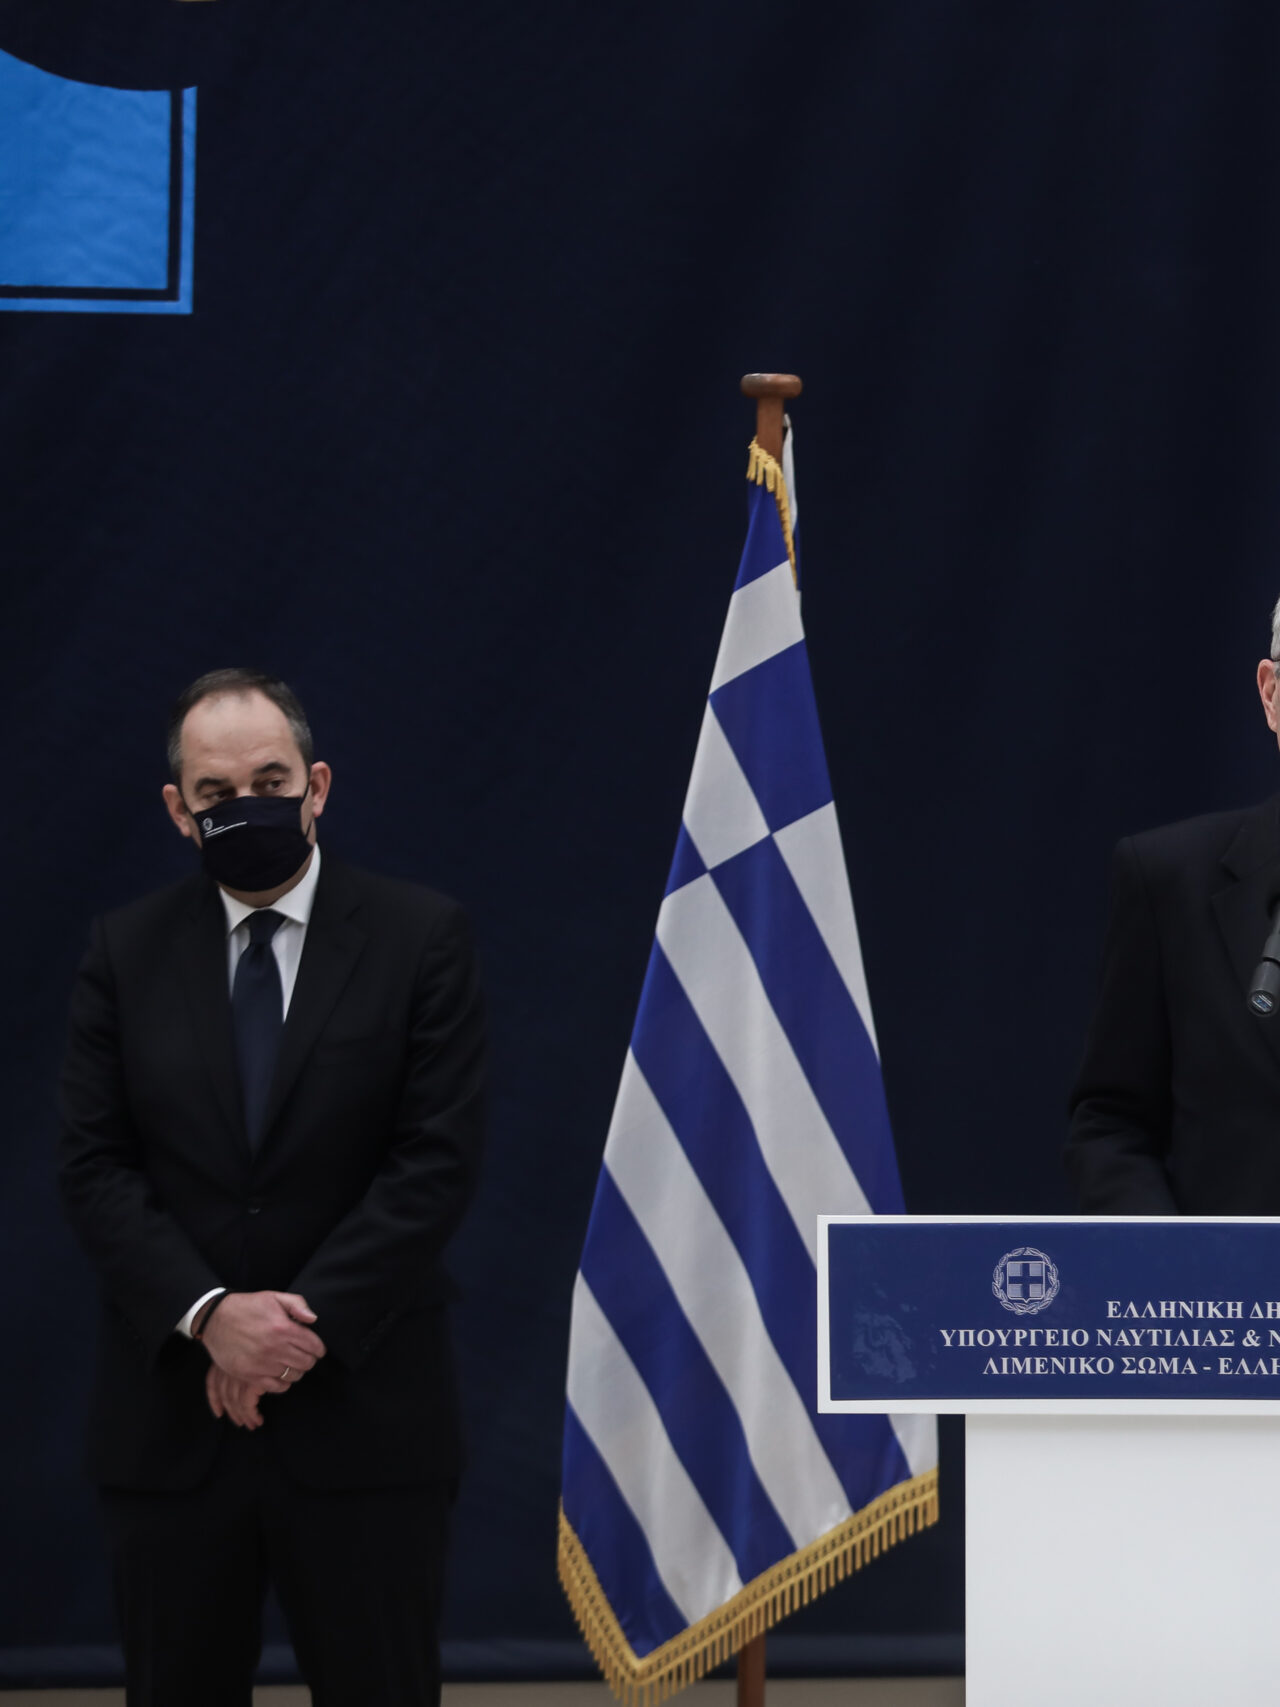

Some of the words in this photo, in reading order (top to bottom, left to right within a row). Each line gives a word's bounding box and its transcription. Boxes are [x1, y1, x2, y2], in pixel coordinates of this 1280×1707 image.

[1107, 1300, 1244, 1319] ΕΛΛΗΝΙΚΗ
[939, 1328, 1089, 1347] ΥΠΟΥΡΓΕΙΟ
[1096, 1329, 1235, 1347] ΝΑΥΤΙΛΙΑΣ
[1242, 1329, 1261, 1347] &
[983, 1356, 1115, 1375] ΛΙΜΕΝΙΚΟ
[1121, 1356, 1198, 1375] ΣΩΜΑ
